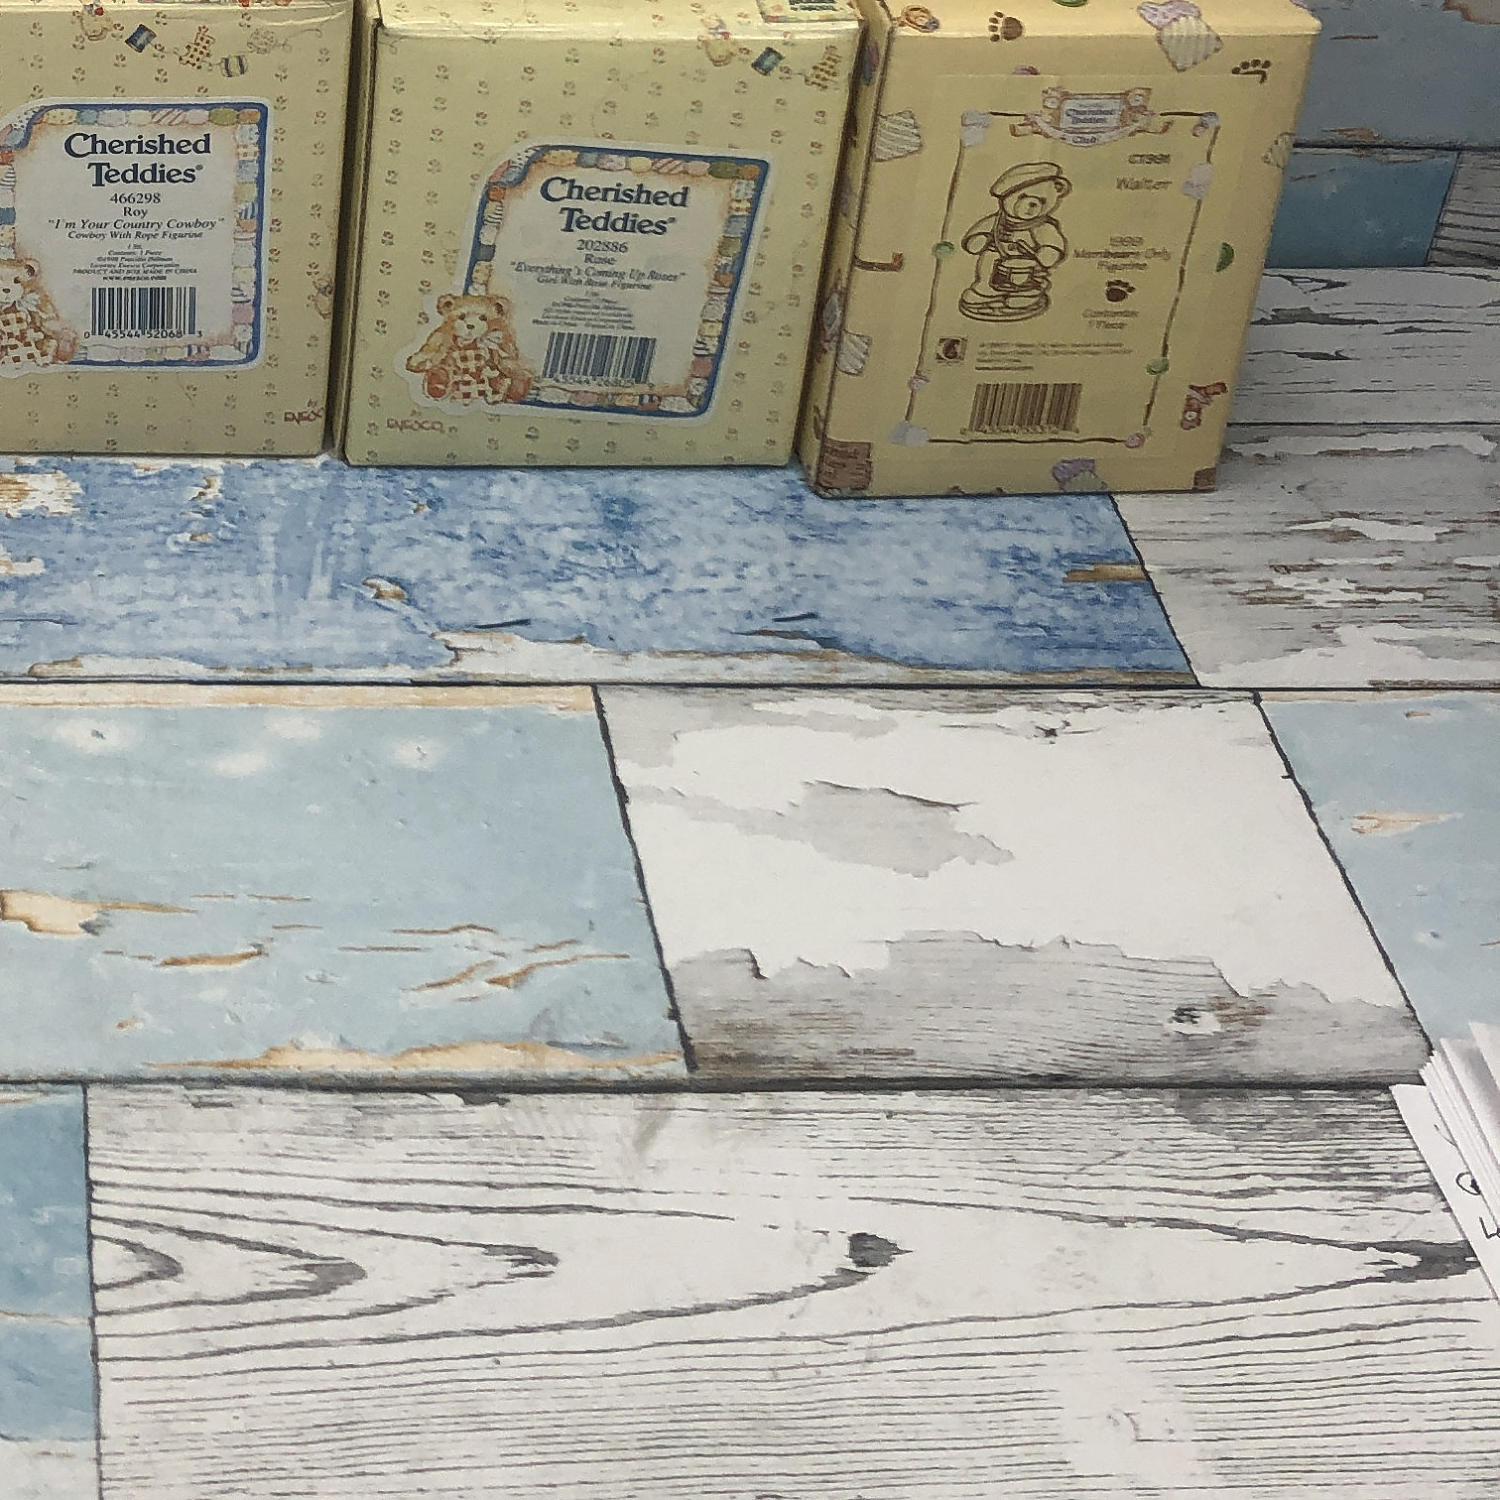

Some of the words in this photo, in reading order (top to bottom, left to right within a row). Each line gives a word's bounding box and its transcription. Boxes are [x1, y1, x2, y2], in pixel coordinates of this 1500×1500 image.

[64, 133, 211, 158] Cherished
[87, 162, 197, 187] Teddies
[1116, 178, 1172, 190] Walter
[540, 176, 691, 207] Cherished
[109, 193, 161, 204] 466298
[123, 206, 148, 219] Roy
[80, 219, 110, 229] Your
[113, 219, 162, 231] Country
[559, 206, 668, 236] Teddies
[68, 230, 107, 241] Cowboy
[110, 230, 132, 239] With
[135, 230, 158, 240] Rope
[161, 230, 203, 240] Figurine
[576, 238, 629, 253] 202886
[584, 253, 616, 265] Rose
[104, 330, 141, 339] 45544
[147, 330, 183, 338] 52068
